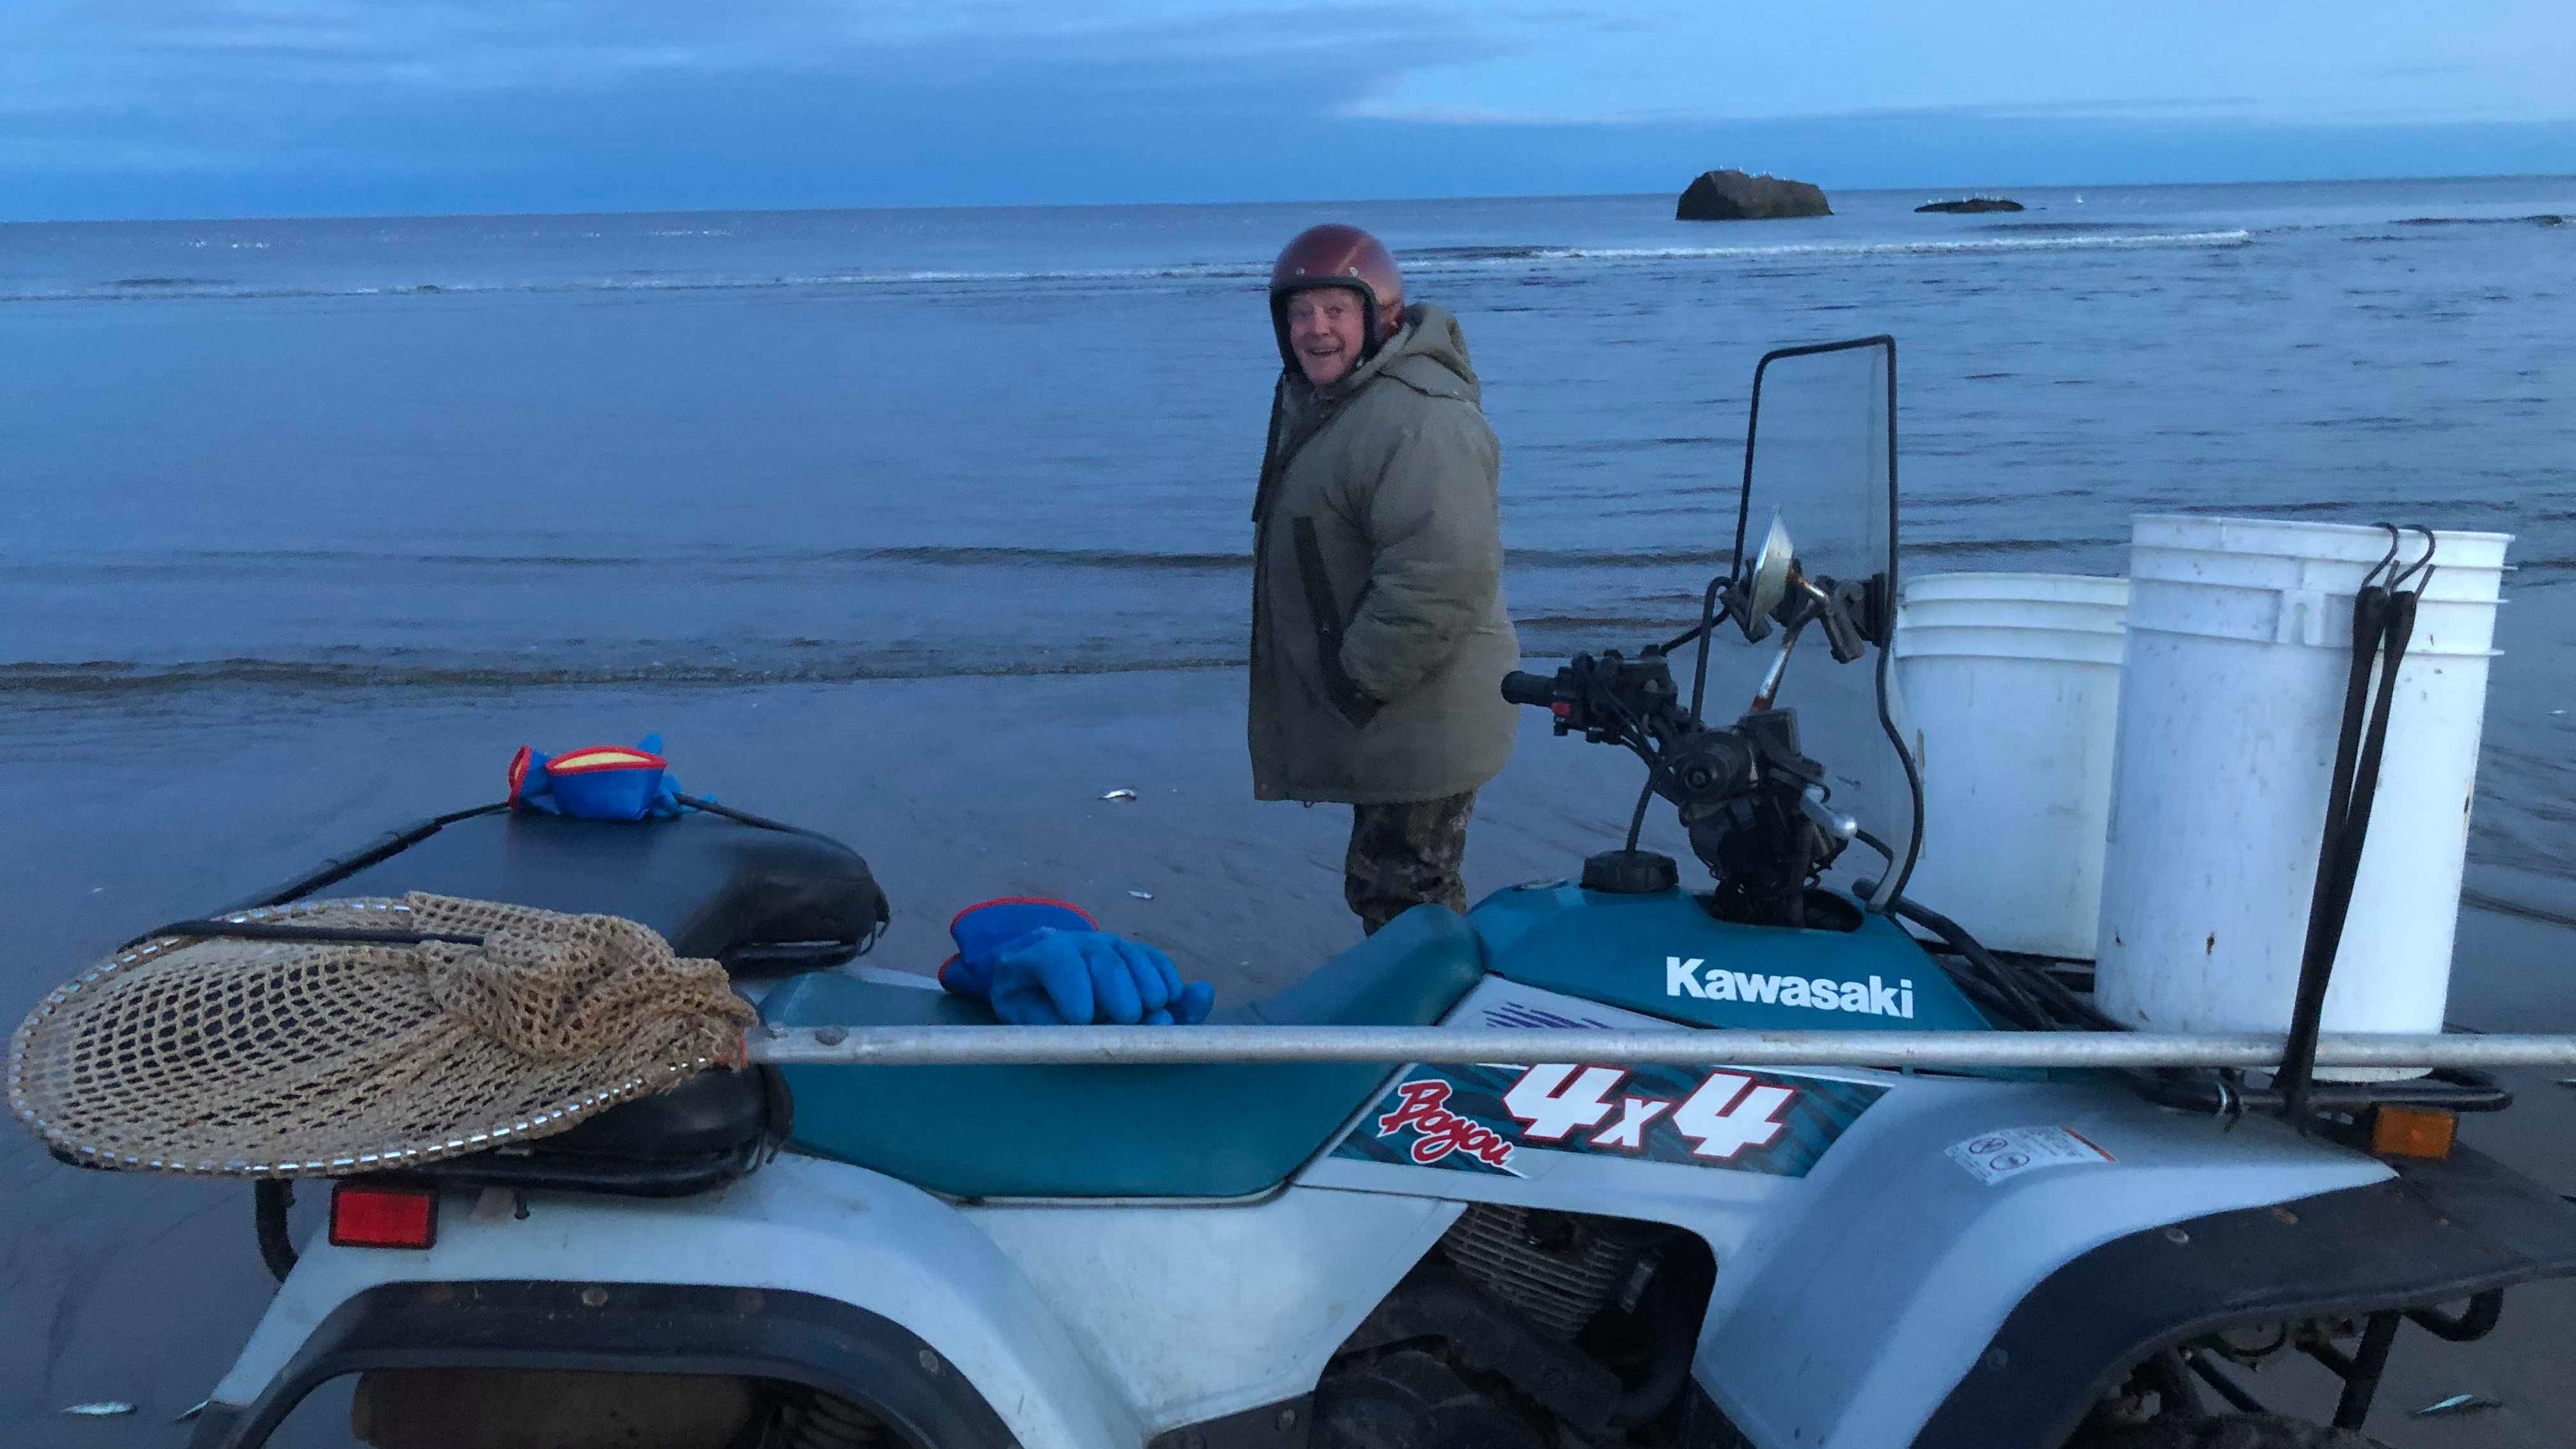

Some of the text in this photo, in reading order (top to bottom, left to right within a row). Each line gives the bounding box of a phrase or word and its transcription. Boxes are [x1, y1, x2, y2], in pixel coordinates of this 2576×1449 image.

[1666, 956, 1913, 1019] Kawasaki
[1378, 1063, 1796, 1166] Bayou 4x4
